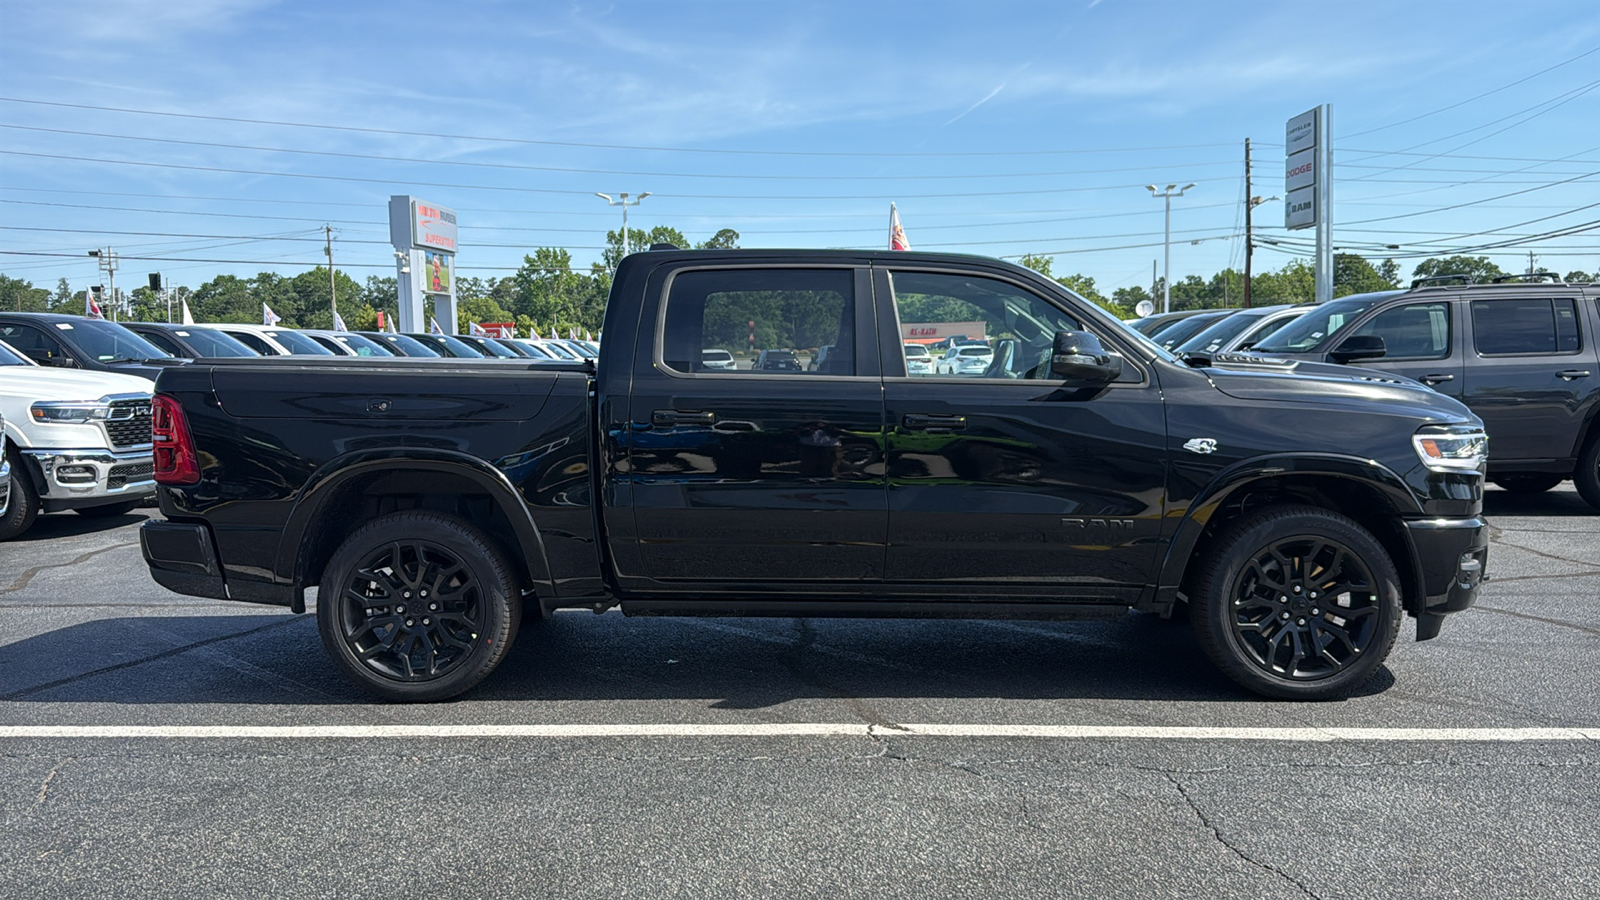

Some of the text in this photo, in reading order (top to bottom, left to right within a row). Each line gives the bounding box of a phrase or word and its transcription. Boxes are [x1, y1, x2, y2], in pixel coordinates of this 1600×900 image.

[1287, 122, 1311, 135] CHRYSLER
[1286, 163, 1312, 178] DODGE
[1291, 201, 1311, 213] RAM
[1061, 518, 1133, 529] RAM
